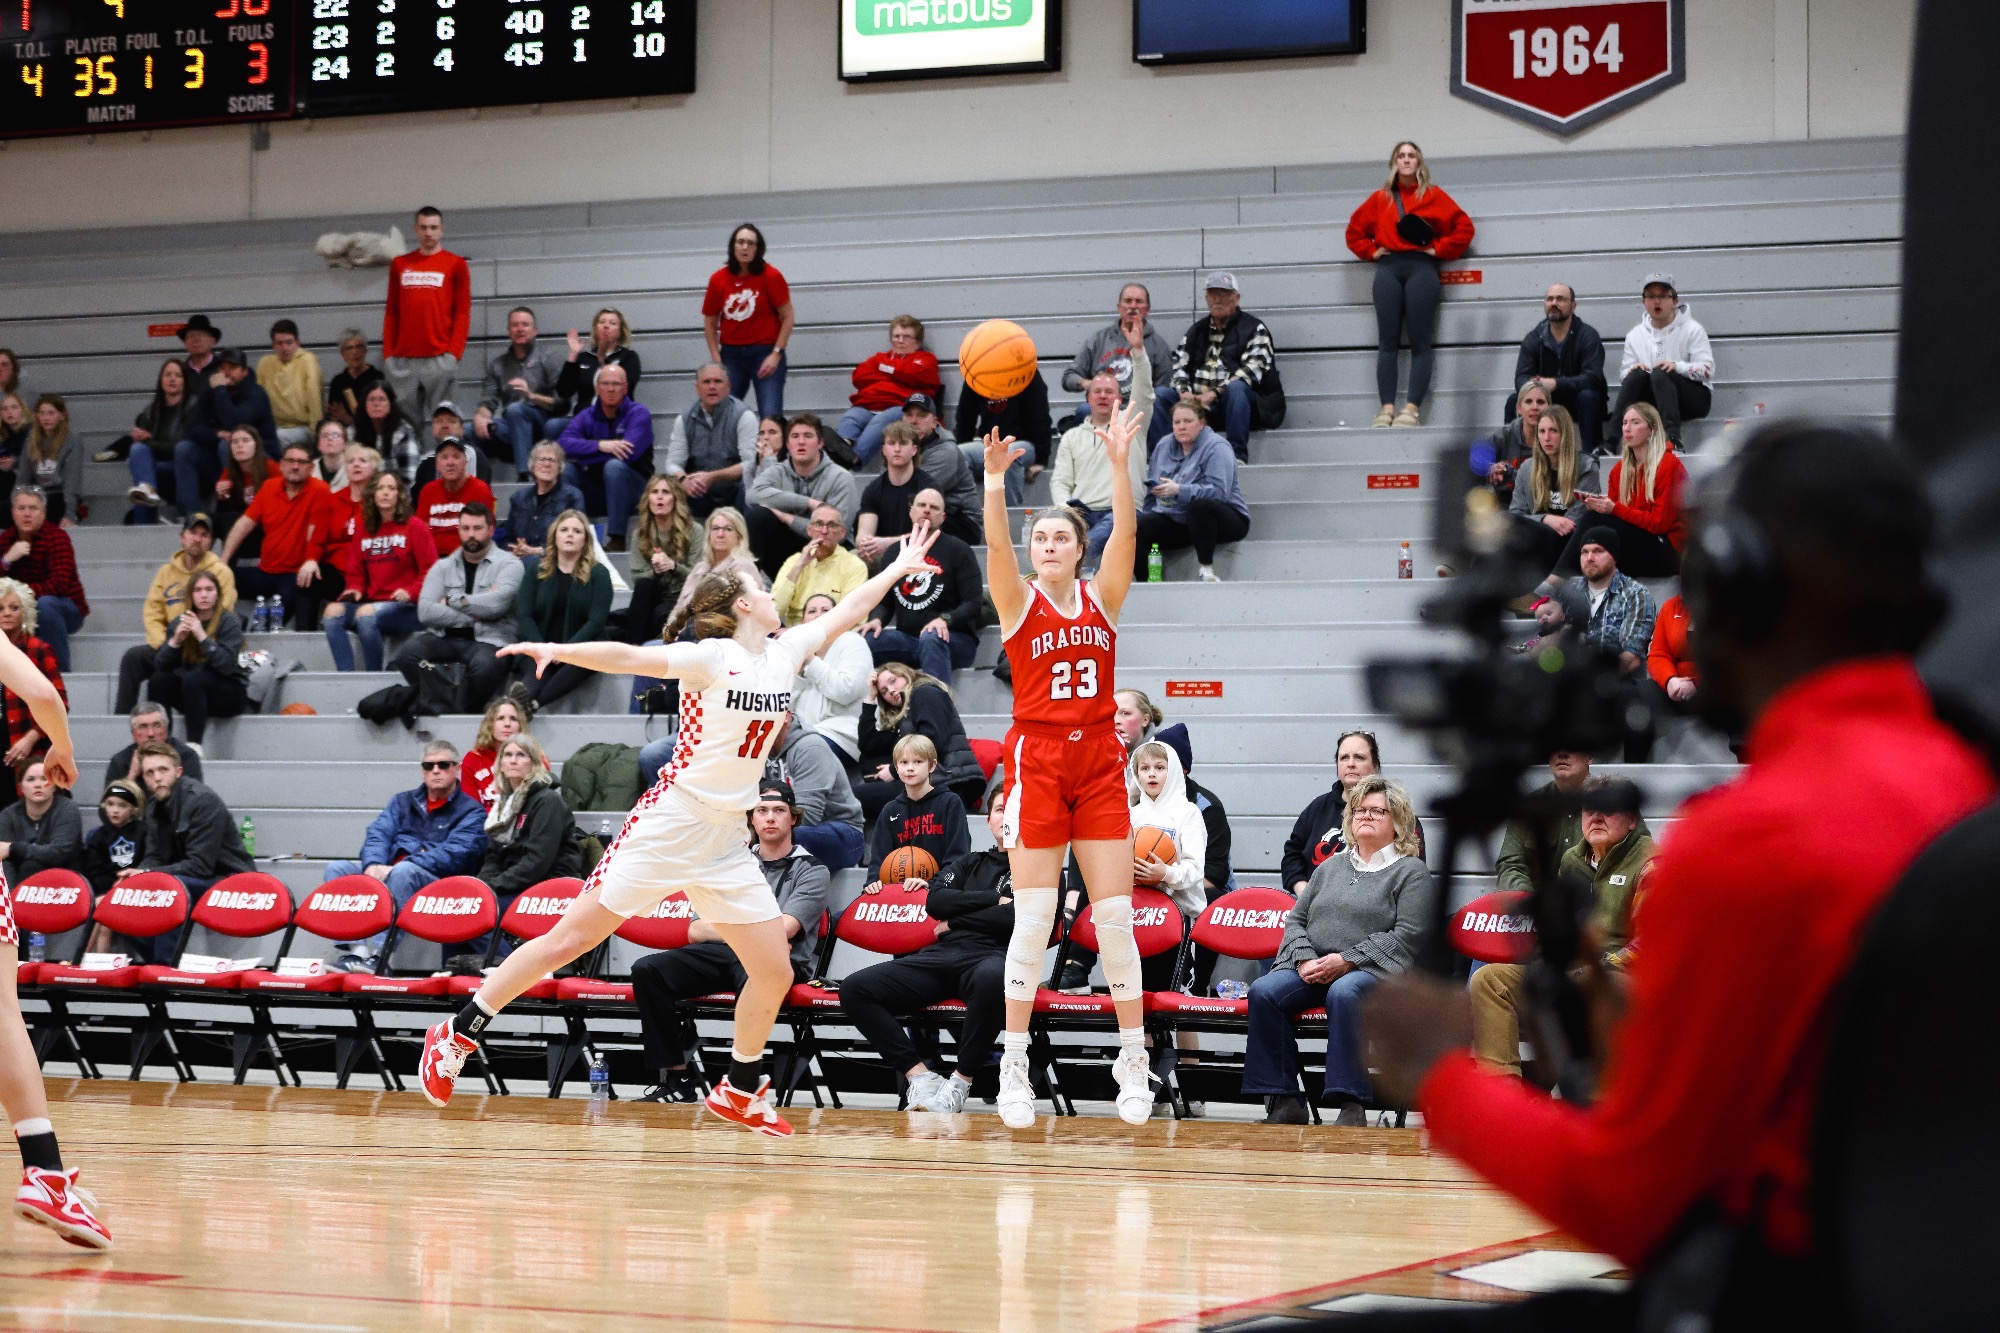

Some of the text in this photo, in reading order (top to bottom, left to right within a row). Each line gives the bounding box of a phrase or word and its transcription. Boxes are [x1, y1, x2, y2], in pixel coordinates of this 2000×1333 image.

[504, 0, 666, 34] 40 2 14
[65, 32, 160, 55] PLAYER FOUL
[174, 28, 213, 46] T.O.L.
[228, 22, 275, 42] FOULS
[312, 15, 455, 49] 23 2 6
[248, 42, 268, 85] 3
[503, 32, 666, 67] 45 1 10
[1508, 21, 1625, 80] 1964
[74, 55, 153, 97] 35 1
[184, 47, 204, 89] 3
[312, 48, 454, 81] 24 2 4
[22, 63, 43, 98] 4
[87, 104, 136, 124] MATCH
[228, 94, 274, 114] SCORE
[1031, 625, 1111, 661] DRAGONS
[1050, 657, 1099, 700] 23
[725, 684, 791, 713] HUSKIES
[737, 719, 775, 759] 11
[898, 854, 910, 882] ALDING
[15, 885, 81, 905] DRAGONS
[110, 888, 178, 908] DRAGONS
[207, 889, 278, 910] DRAGONS
[309, 892, 379, 912] DRAGONS
[412, 895, 483, 915] DRAGONS
[516, 896, 577, 916] DRAGO
[854, 902, 928, 923] DRAGONS
[1461, 911, 1535, 933] DRAGON
